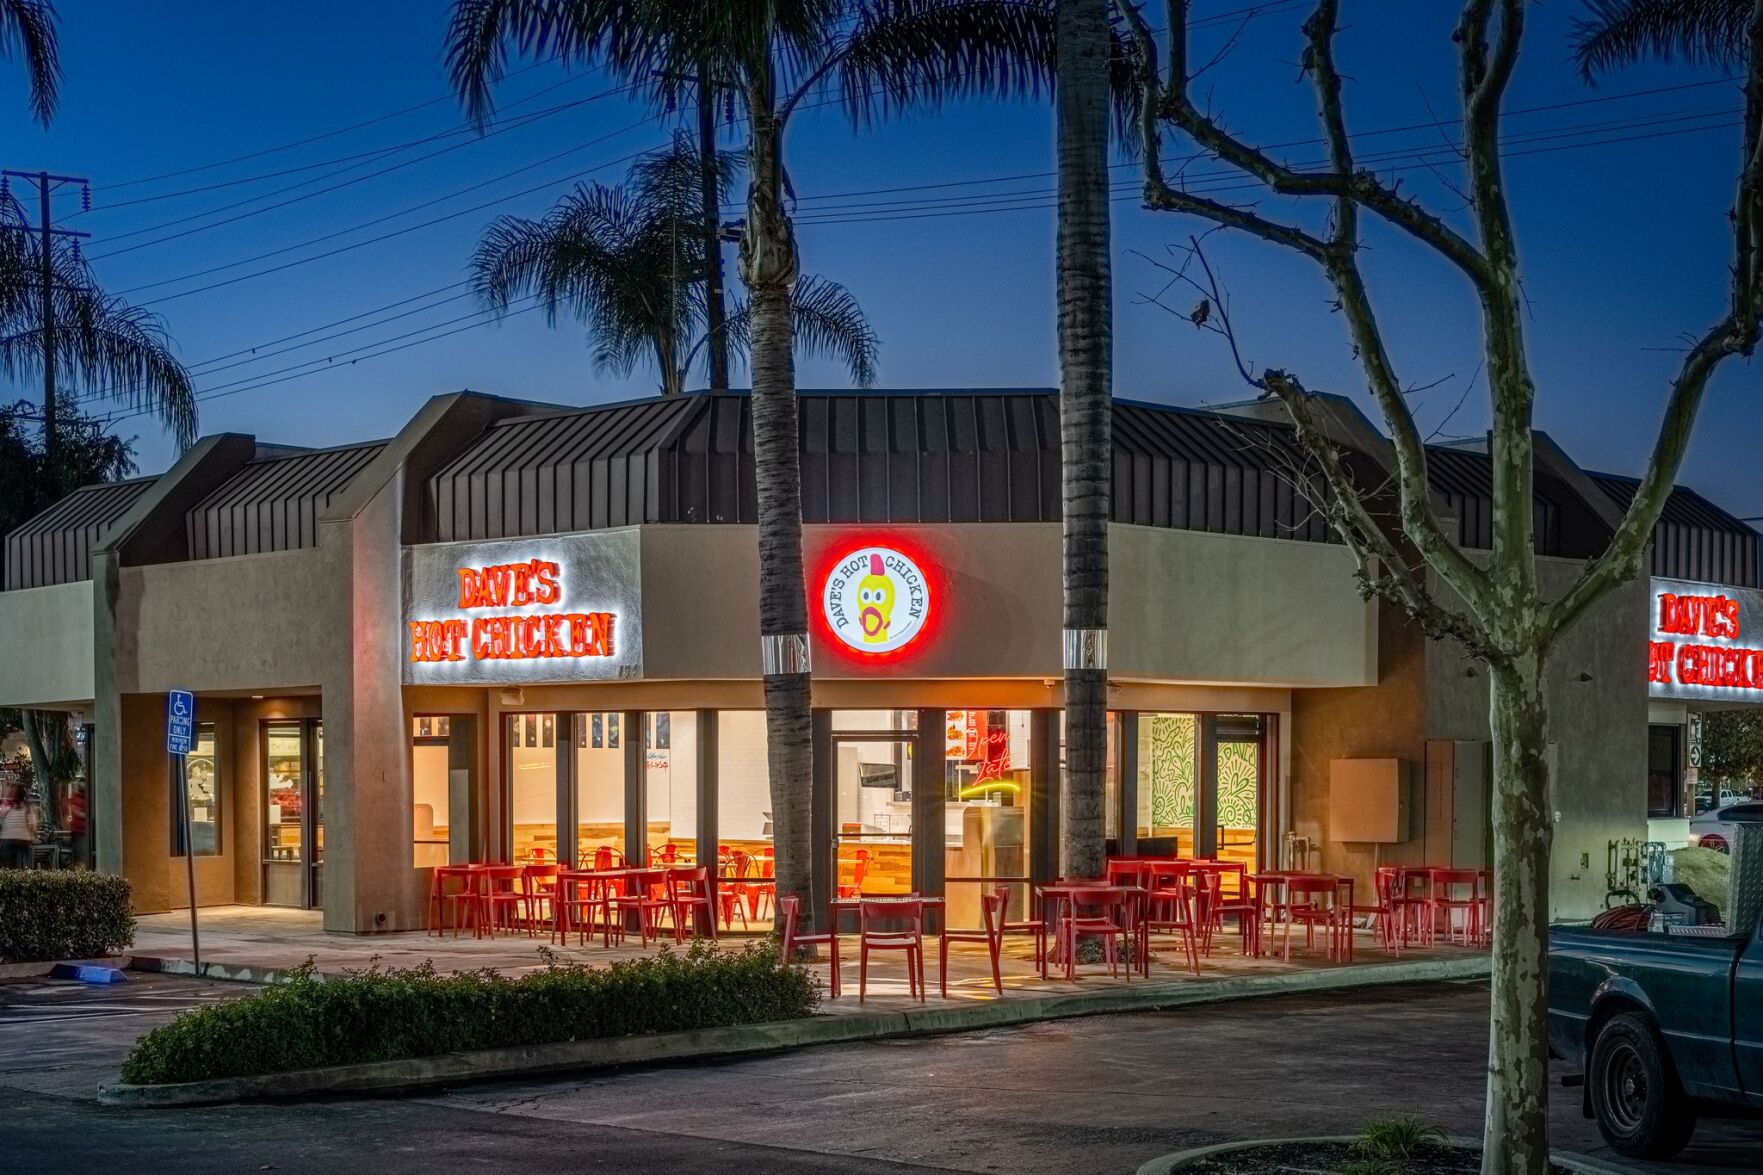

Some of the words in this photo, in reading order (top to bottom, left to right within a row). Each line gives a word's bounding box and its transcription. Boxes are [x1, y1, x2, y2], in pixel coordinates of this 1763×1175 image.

[458, 559, 562, 608] DAVE'S
[830, 578, 849, 629] DAVE'S
[840, 555, 868, 579] HOT
[885, 556, 923, 619] CHICKEN
[410, 619, 467, 662] HOT
[471, 612, 617, 660] CHICKEN
[1659, 593, 1739, 640] DAVE'S
[1648, 640, 1675, 684] OT
[1676, 643, 1763, 689] CHICK
